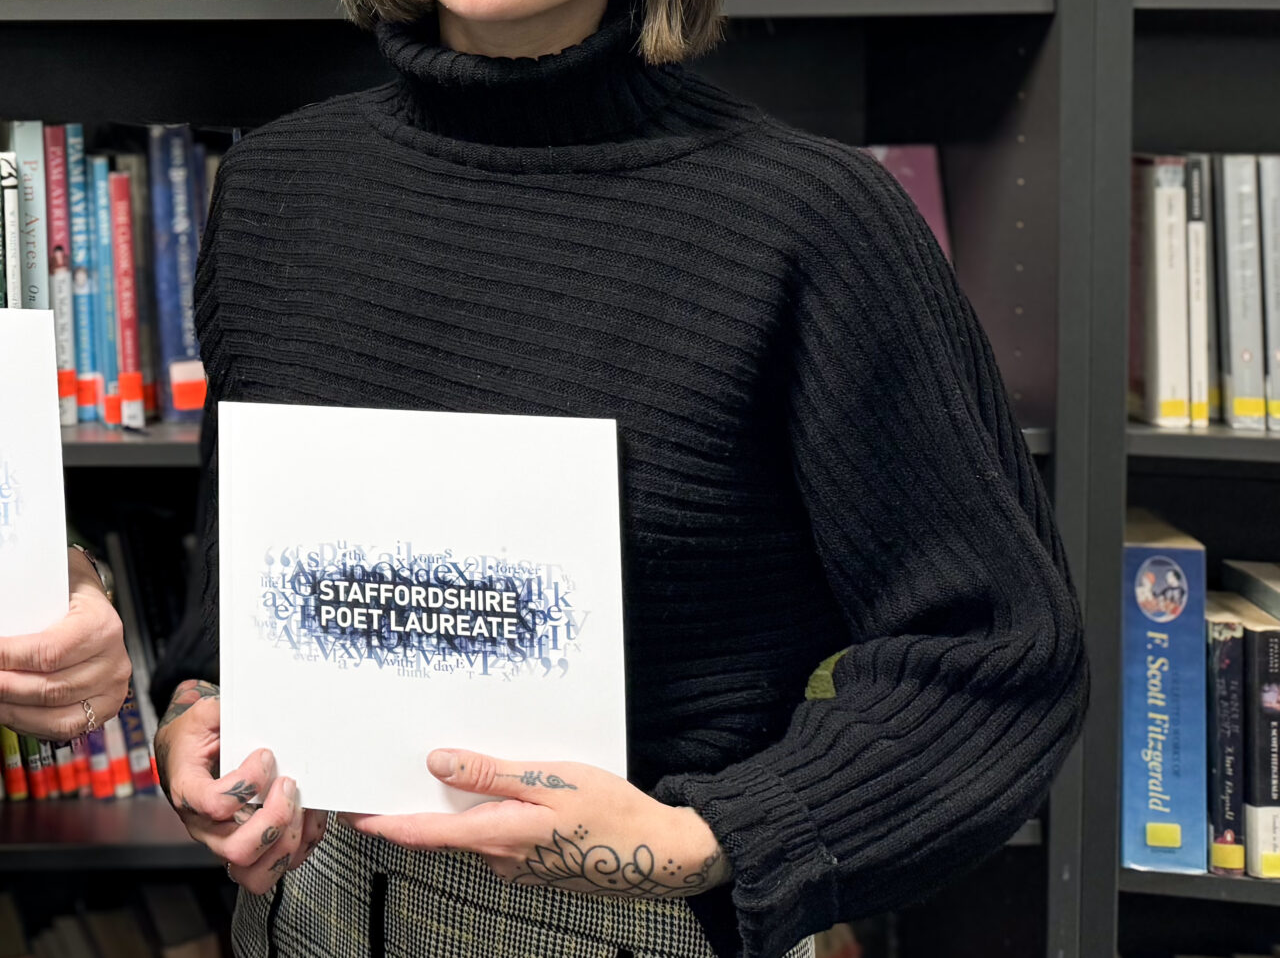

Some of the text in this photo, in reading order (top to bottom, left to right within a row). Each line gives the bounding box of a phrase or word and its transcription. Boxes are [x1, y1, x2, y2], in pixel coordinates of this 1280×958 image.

[20, 159, 41, 302] Pam Ayres On
[48, 145, 66, 242] PAM AYRES
[68, 136, 89, 264] PAM AYRES
[320, 580, 518, 613] STAFFORDSHIRE
[320, 606, 518, 639] POET LAUREATE
[433, 660, 456, 675] day
[1140, 629, 1172, 814] F. Scott Fitzgerald
